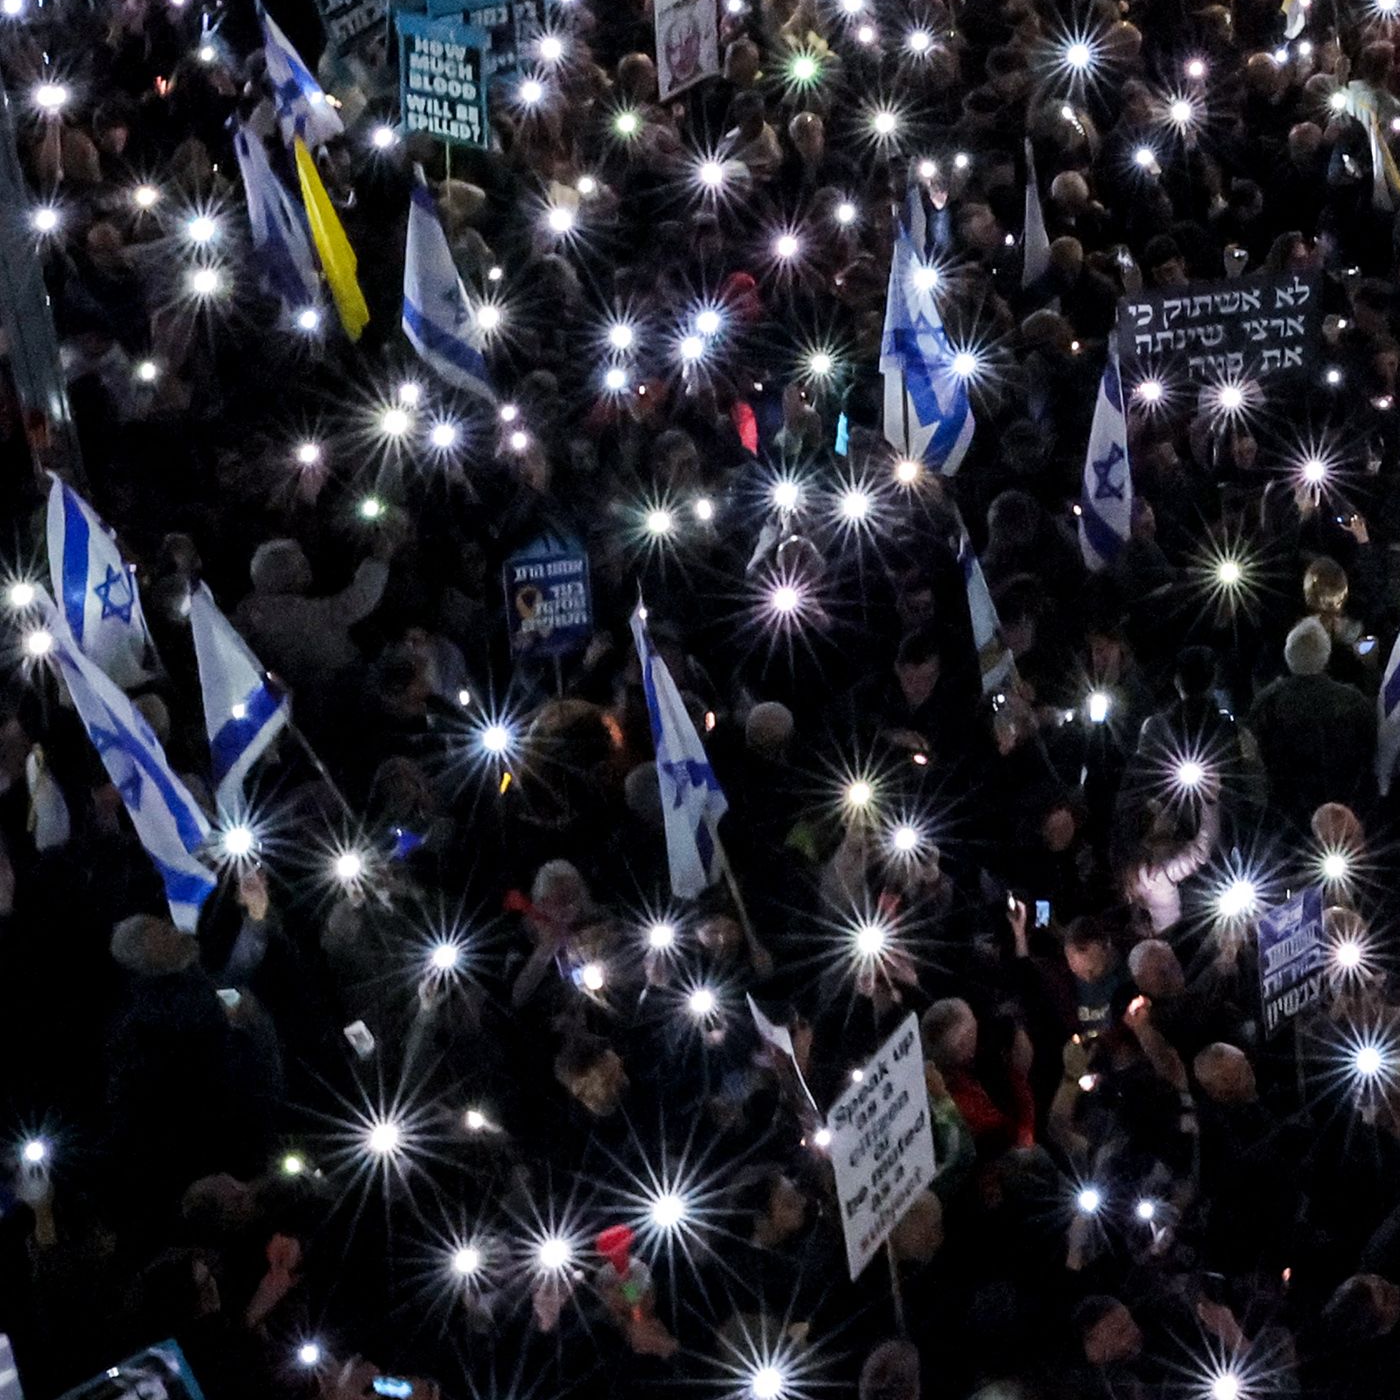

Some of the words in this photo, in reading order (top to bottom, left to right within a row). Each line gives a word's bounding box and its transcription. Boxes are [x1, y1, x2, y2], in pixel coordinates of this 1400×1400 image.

[415, 35, 467, 61] HOW
[409, 53, 473, 80] MUCH
[409, 69, 477, 100] BLOOD
[407, 94, 452, 119] WILL
[457, 104, 479, 125] BE
[408, 112, 480, 142] SPILLED?
[1274, 276, 1310, 309] לא
[1128, 304, 1153, 327] כי
[1163, 289, 1261, 330] אשתוק
[1135, 324, 1224, 355] שינתה
[1243, 315, 1305, 341] ארצי
[1260, 347, 1303, 371] את
[893, 1032, 913, 1061] up
[883, 1082, 893, 1100] a
[846, 1186, 868, 1218] be
